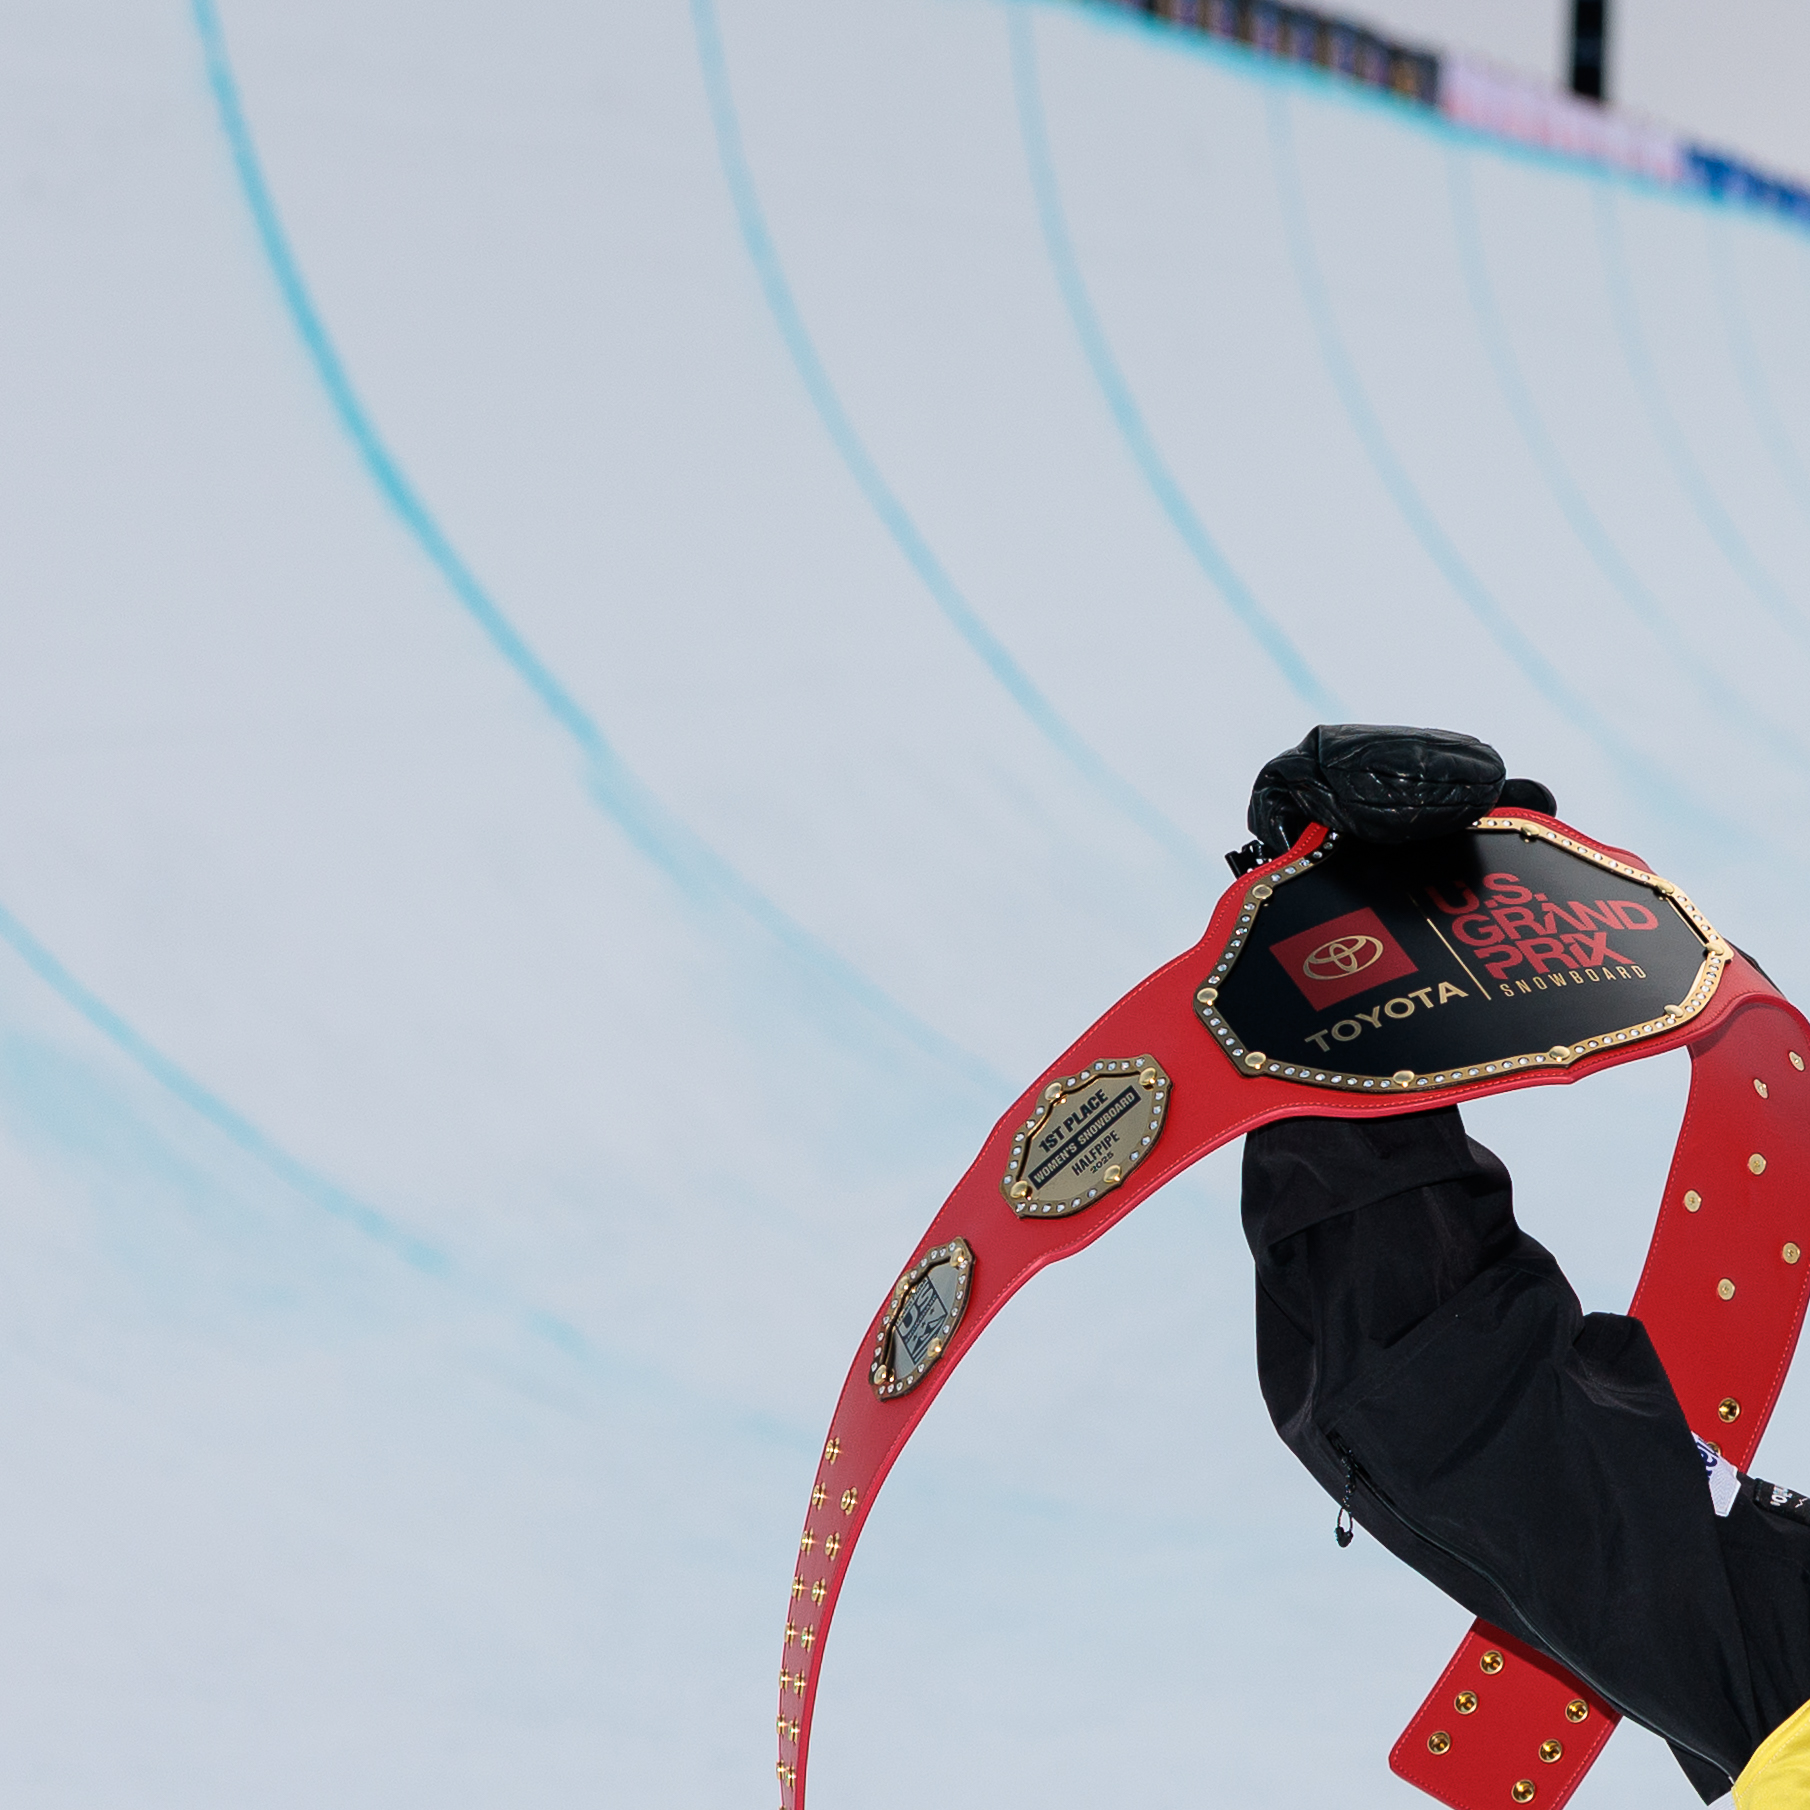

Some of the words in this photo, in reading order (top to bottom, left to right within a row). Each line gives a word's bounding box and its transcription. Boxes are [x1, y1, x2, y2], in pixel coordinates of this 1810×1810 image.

[1424, 872, 1549, 917] U.S.
[1452, 899, 1659, 947] GRAND
[1473, 932, 1636, 980] PRIX
[1500, 965, 1647, 997] SNOWBOARD
[1305, 981, 1469, 1053] TOYOTA
[1033, 1142, 1077, 1183] WOMEN'S
[1077, 1092, 1135, 1145] SNOWBOARD
[1038, 1126, 1066, 1153] 1ST
[1063, 1089, 1109, 1132] PLACE
[1071, 1130, 1120, 1176] HALFPIPE
[1090, 1152, 1115, 1174] 2025
